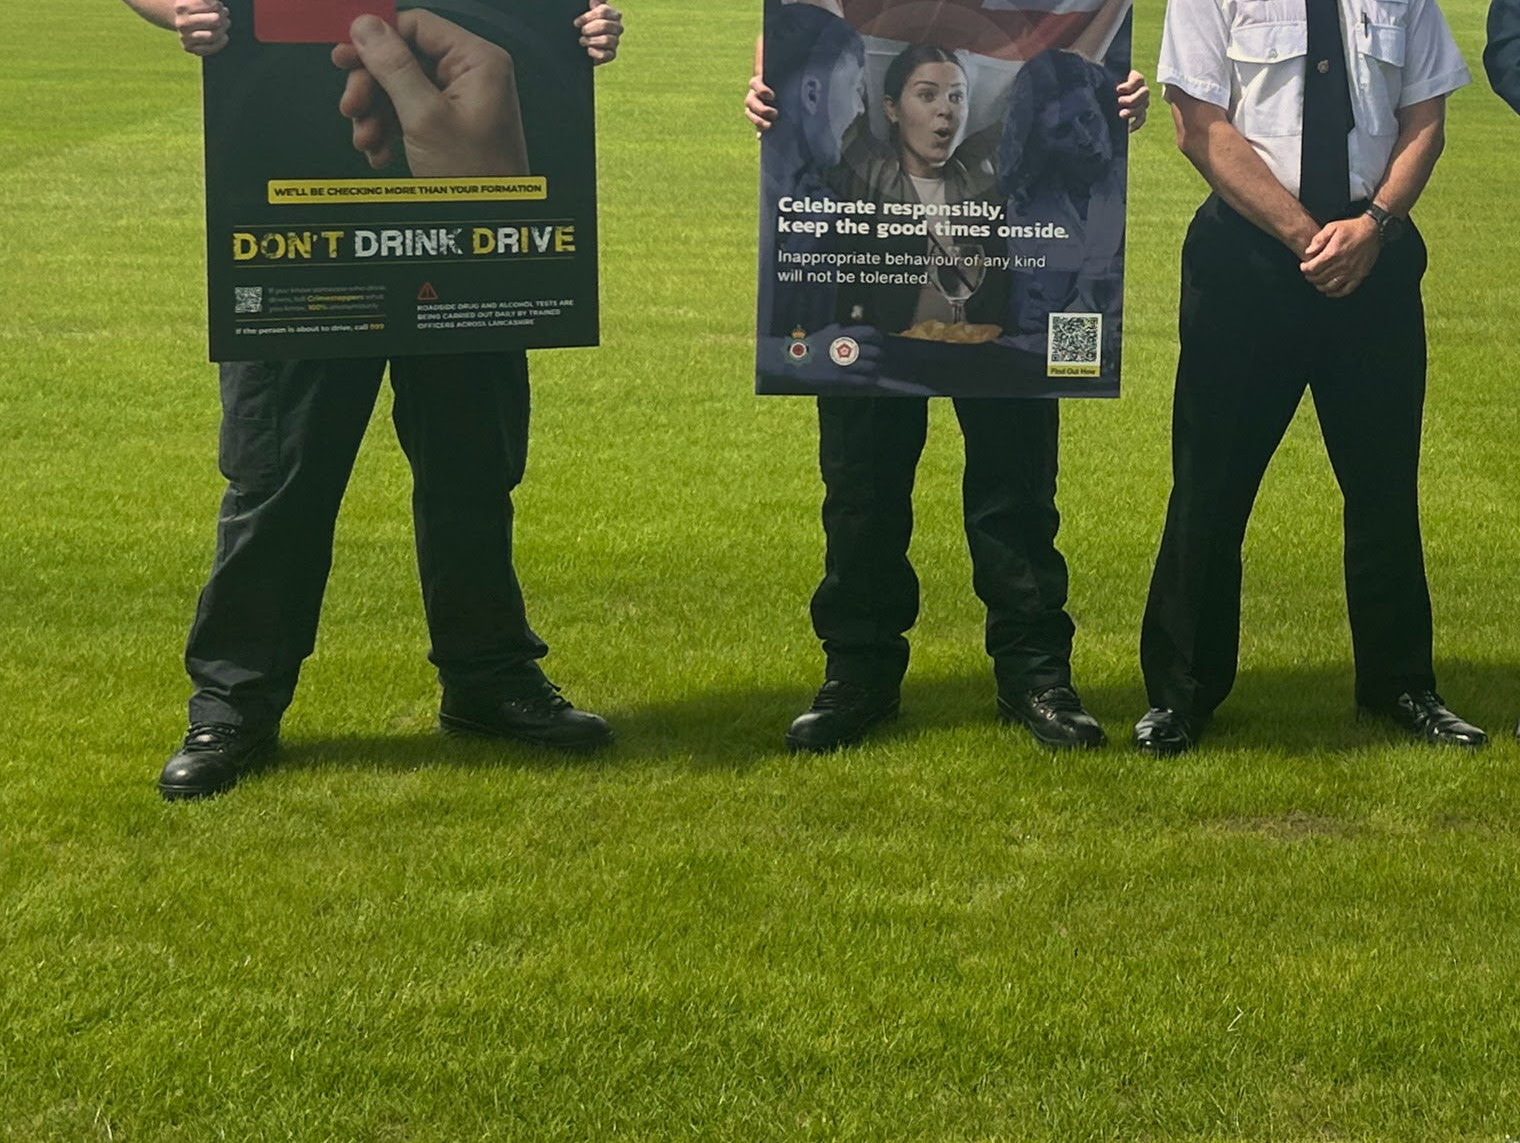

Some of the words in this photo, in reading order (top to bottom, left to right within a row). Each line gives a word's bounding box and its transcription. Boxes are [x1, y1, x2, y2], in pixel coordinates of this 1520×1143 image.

[310, 187, 325, 196] BE
[327, 186, 382, 196] CHECKING
[385, 186, 417, 195] MORE
[418, 185, 448, 194] THAN
[450, 185, 479, 194] YOUR
[481, 184, 542, 194] FORMATION
[778, 196, 876, 214] Celebrate
[883, 199, 1005, 221] responsibly,
[778, 217, 829, 237] keep
[835, 218, 870, 235] the
[877, 220, 928, 239] good
[934, 220, 990, 238] times
[997, 222, 1070, 239] onside.
[233, 231, 344, 261] DON'T
[354, 228, 463, 257] DRINK
[472, 225, 576, 255] DRIVE
[778, 250, 881, 268] Inappropriate
[885, 252, 961, 267] behaviour
[964, 253, 980, 266] of
[983, 256, 1009, 271] any
[1015, 254, 1046, 268] kind
[778, 270, 802, 283] will
[807, 272, 832, 284] not
[836, 271, 855, 284] be
[860, 272, 931, 285] tolerated.
